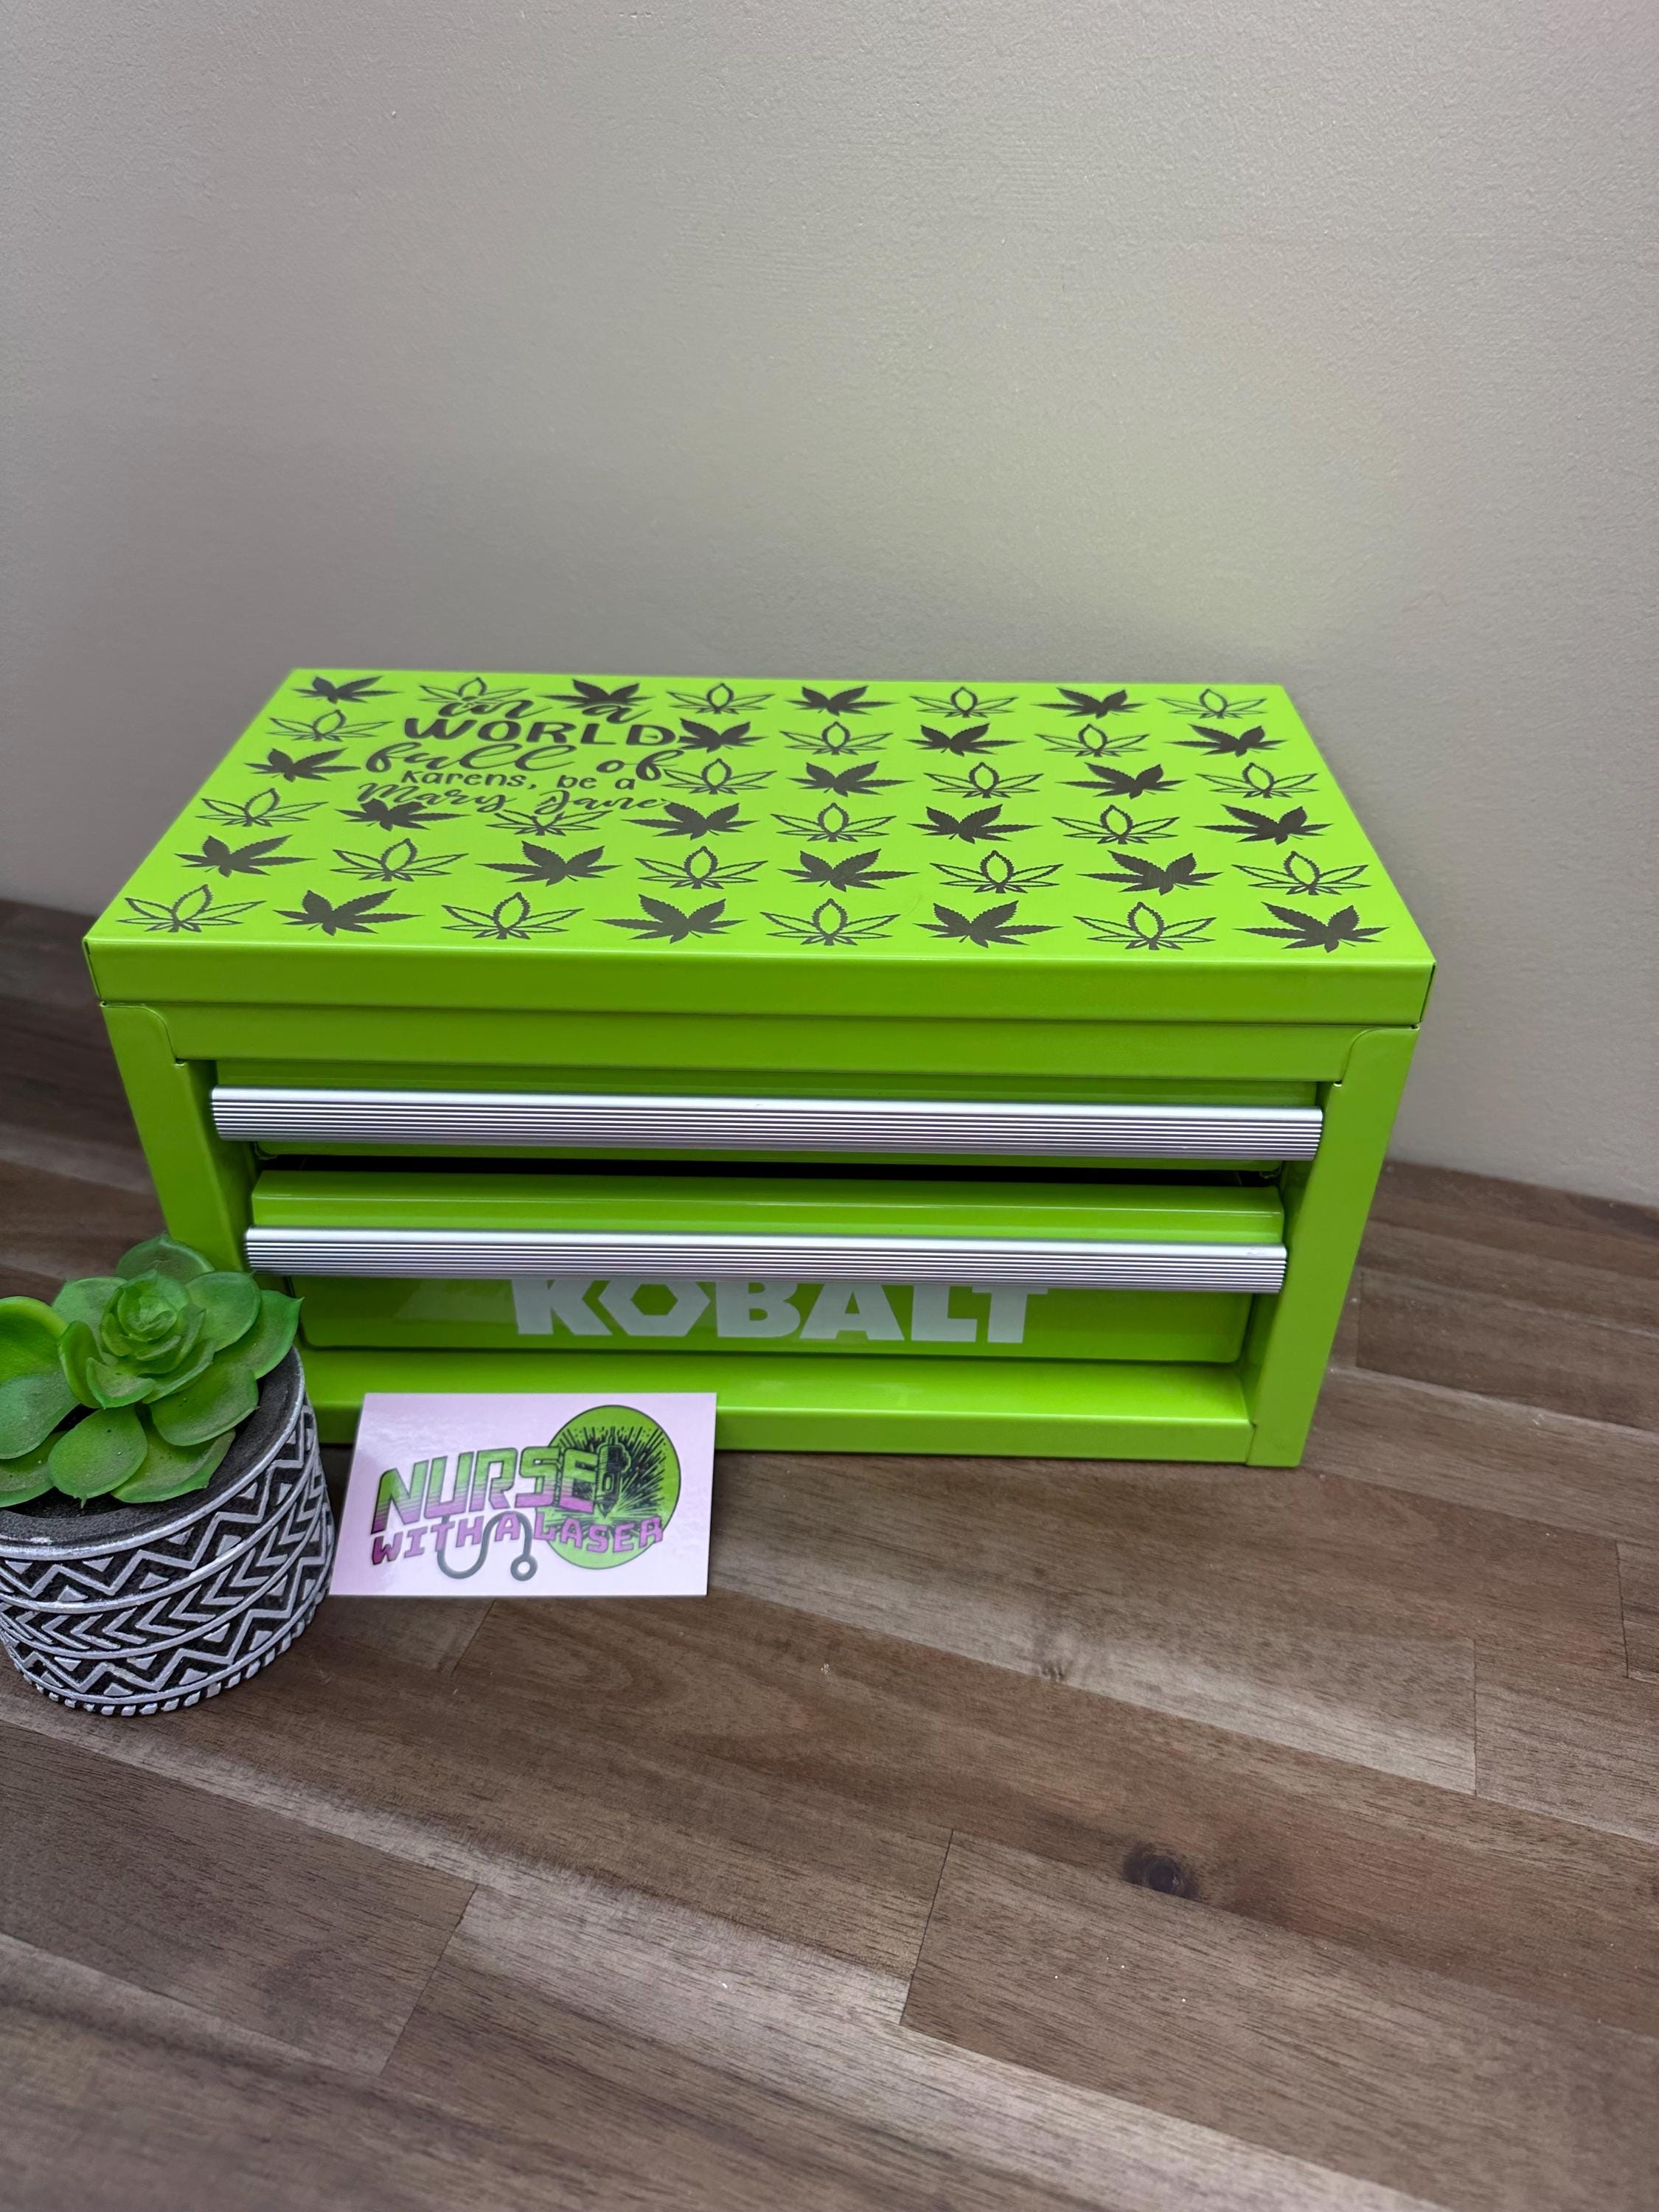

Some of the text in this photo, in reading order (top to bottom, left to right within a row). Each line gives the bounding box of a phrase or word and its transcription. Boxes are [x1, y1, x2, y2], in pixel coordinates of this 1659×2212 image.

[403, 717, 676, 745] WORLD
[582, 704, 652, 724] a
[366, 742, 684, 780] full of
[358, 782, 666, 815] Mary Jane
[557, 775, 597, 790] be
[615, 778, 635, 790] a
[512, 1279, 1047, 1343] KOBALT
[371, 1446, 599, 1534] NURSE
[371, 1514, 481, 1565] WITH
[532, 1509, 664, 1554] LASER
